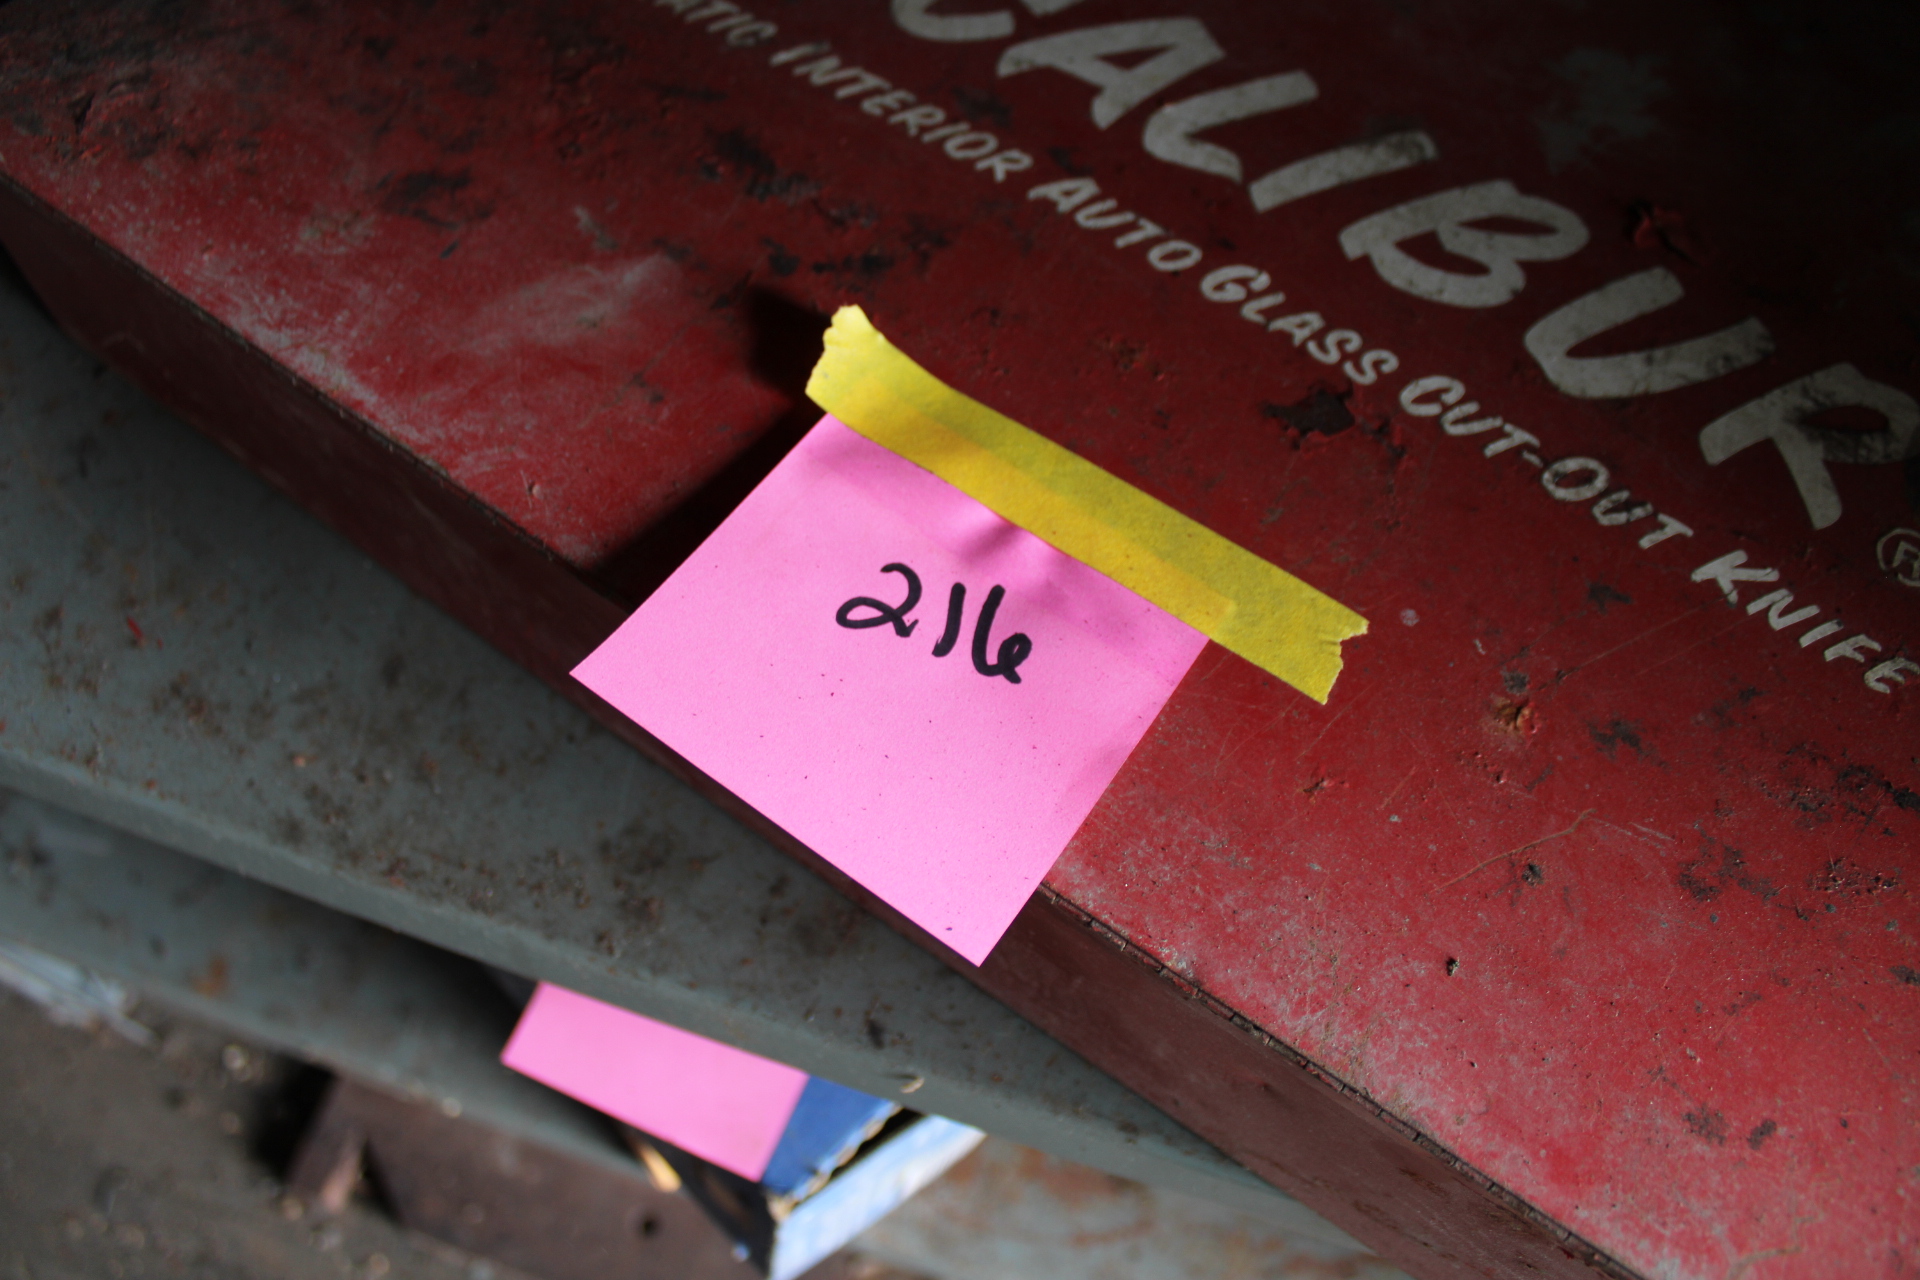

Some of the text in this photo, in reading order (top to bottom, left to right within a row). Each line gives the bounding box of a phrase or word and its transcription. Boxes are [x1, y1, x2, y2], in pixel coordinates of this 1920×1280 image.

[770, 42, 1034, 181] INTERIOR
[1027, 177, 1202, 272] AUTO
[1200, 265, 1399, 385] GLASS
[1400, 375, 1694, 549] CUT-OUT
[1691, 550, 1920, 694] KNIFE
[835, 562, 1033, 684] 216
